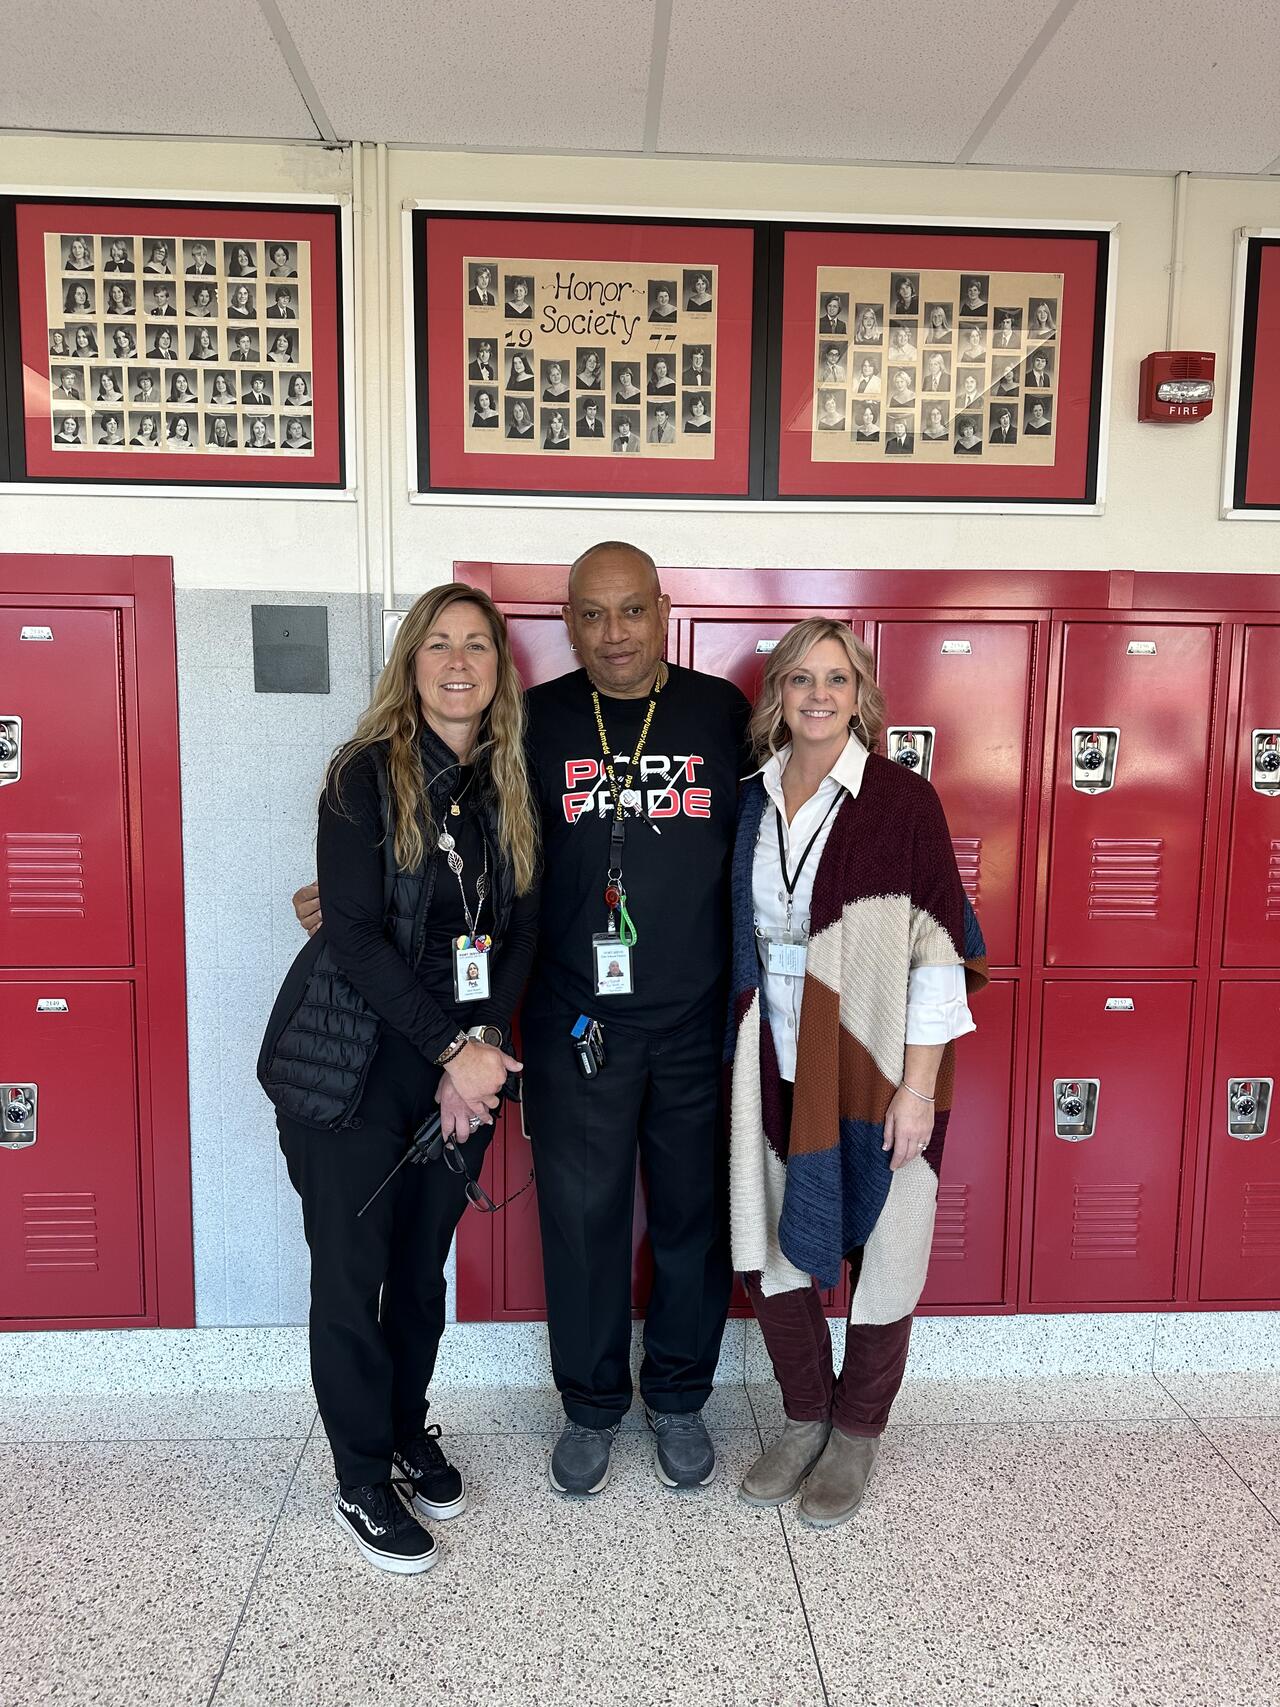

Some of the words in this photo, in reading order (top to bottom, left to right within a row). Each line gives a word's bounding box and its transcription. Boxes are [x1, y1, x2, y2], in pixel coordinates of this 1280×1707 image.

[555, 272, 632, 305] Honor
[540, 305, 640, 345] Society
[1169, 406, 1198, 415] FIRE
[632, 700, 656, 765] goarmy.com/amedd
